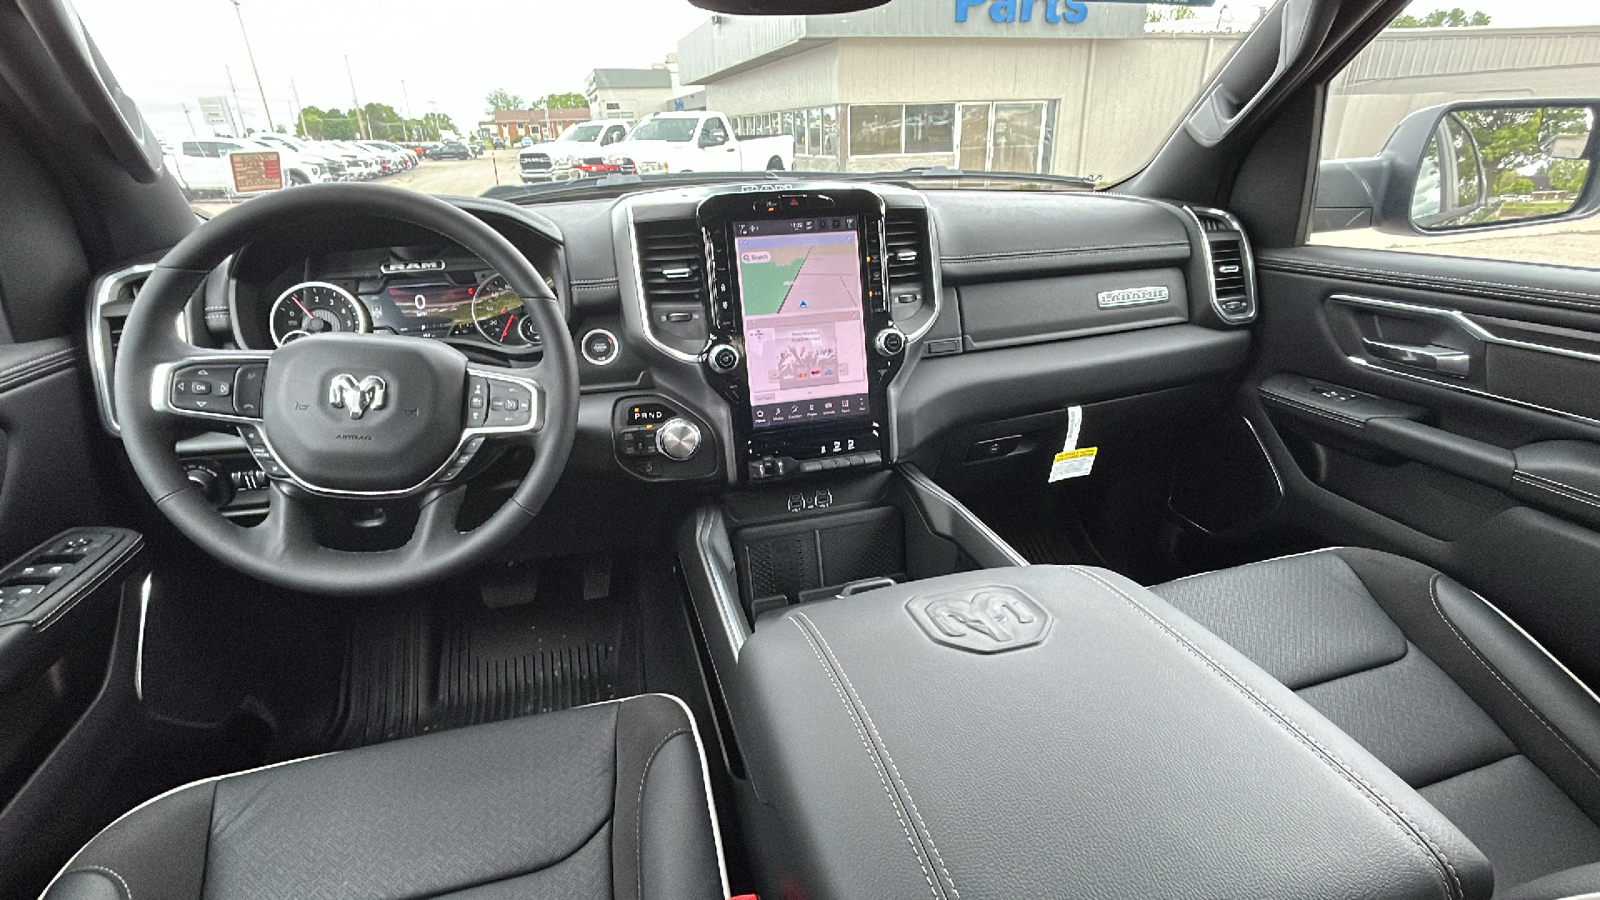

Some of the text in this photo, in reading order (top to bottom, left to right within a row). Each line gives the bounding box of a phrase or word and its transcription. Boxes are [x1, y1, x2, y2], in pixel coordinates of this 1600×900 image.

[955, 0, 1088, 24] Parts
[389, 261, 438, 271] RAM
[414, 294, 427, 311] 0
[1100, 288, 1168, 303] LARAMIE
